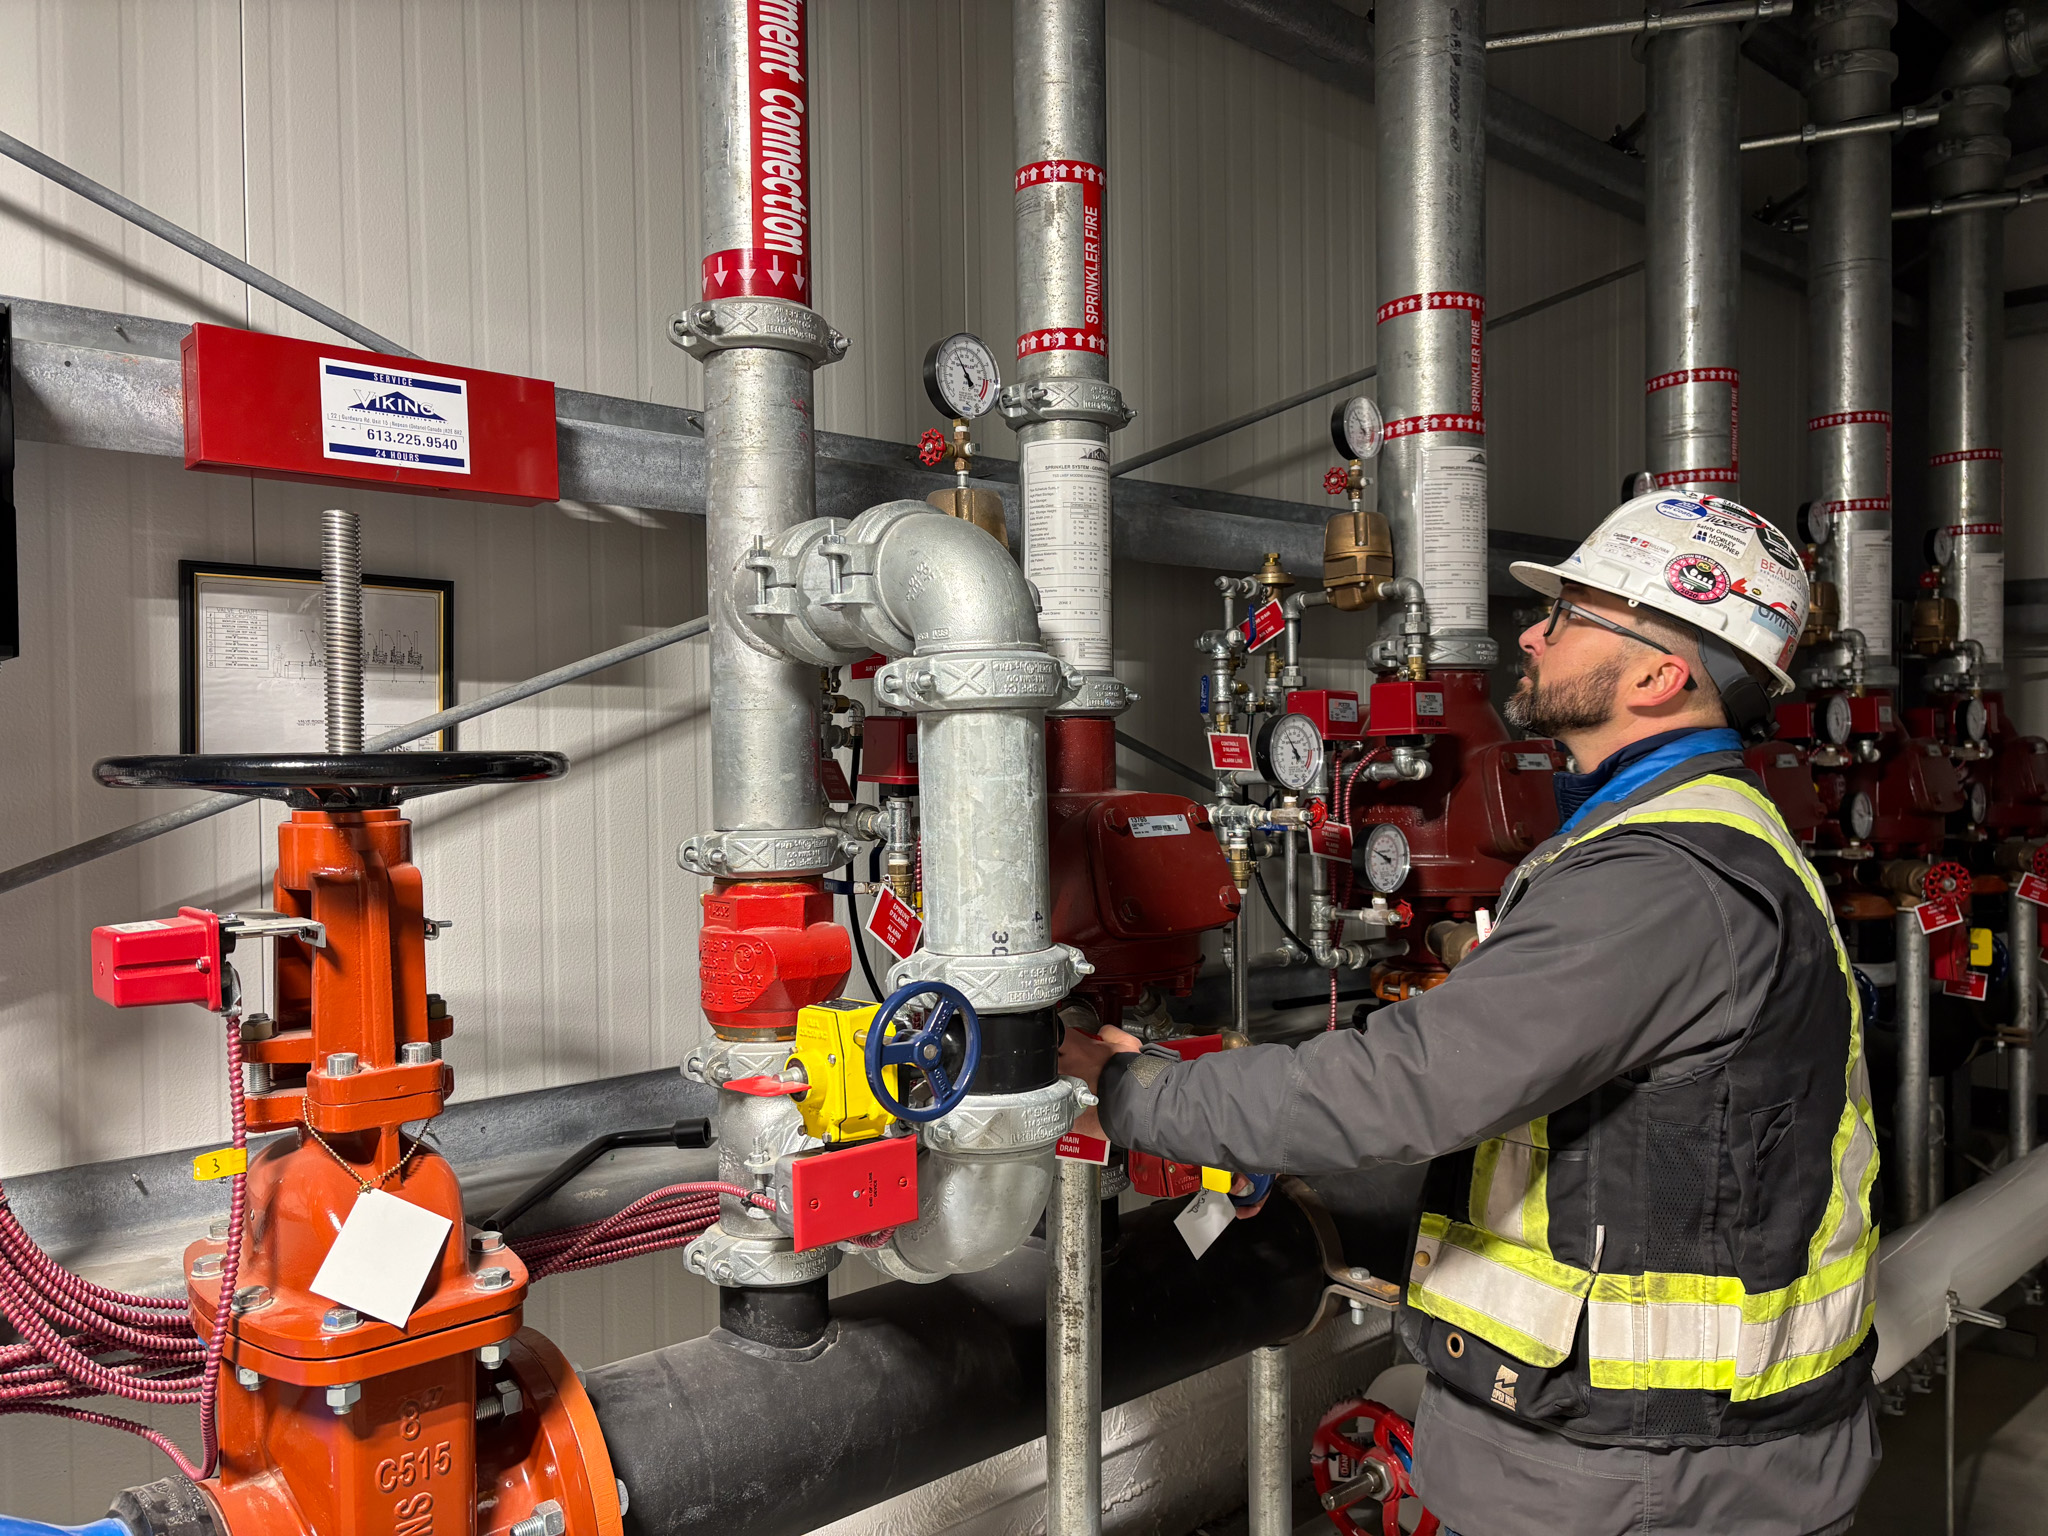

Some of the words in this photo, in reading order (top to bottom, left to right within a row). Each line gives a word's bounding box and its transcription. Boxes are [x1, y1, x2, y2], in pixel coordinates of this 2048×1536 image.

[758, 0, 805, 83] ment
[759, 88, 807, 256] connection
[1085, 205, 1098, 239] FIRE
[1085, 242, 1099, 325] SPRINKLER
[1471, 319, 1480, 346] FIRE
[373, 372, 413, 387] SERVICE
[1471, 348, 1481, 412] SPRINKLER
[353, 388, 435, 416] VIKING
[367, 428, 458, 451] 613.225.9540
[375, 449, 387, 458] 24
[390, 451, 420, 462] HOURS
[1703, 513, 1754, 533] Tweed
[1696, 523, 1716, 533] Safety
[1716, 526, 1747, 546] Orientation
[1708, 533, 1736, 548] MORLEY
[1708, 539, 1740, 557] HOPPNER
[1680, 588, 1698, 599] 2020
[1265, 625, 1275, 634] LINE
[889, 909, 909, 930] D'ALARME
[886, 932, 897, 945] TEST
[887, 924, 902, 940] ALARM
[1059, 1144, 1080, 1154] DRAIN
[1062, 1135, 1080, 1144] MAIN
[212, 1158, 220, 1174] 3
[375, 1440, 452, 1494] C515
